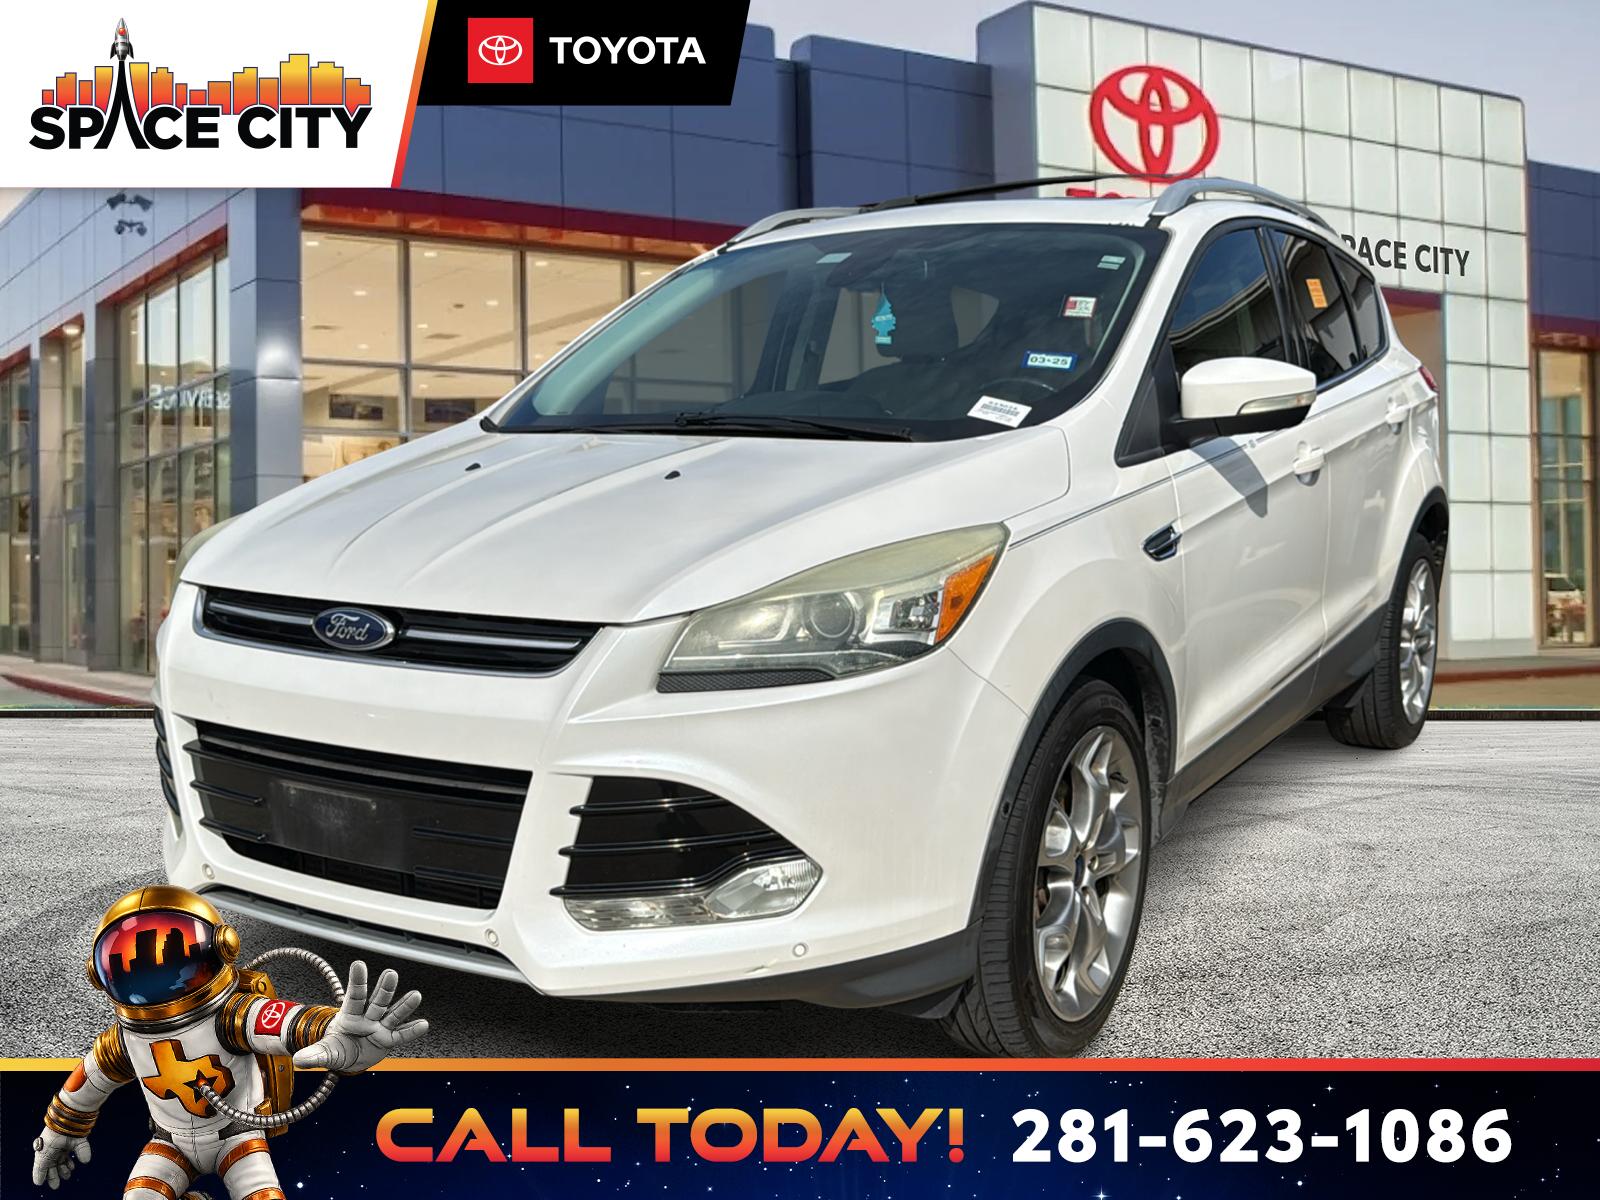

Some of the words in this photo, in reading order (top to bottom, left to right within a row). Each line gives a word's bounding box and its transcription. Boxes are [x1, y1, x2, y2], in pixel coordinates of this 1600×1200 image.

[1341, 233, 1407, 270] PACE
[1414, 243, 1470, 276] CITY
[325, 612, 370, 641] Ford
